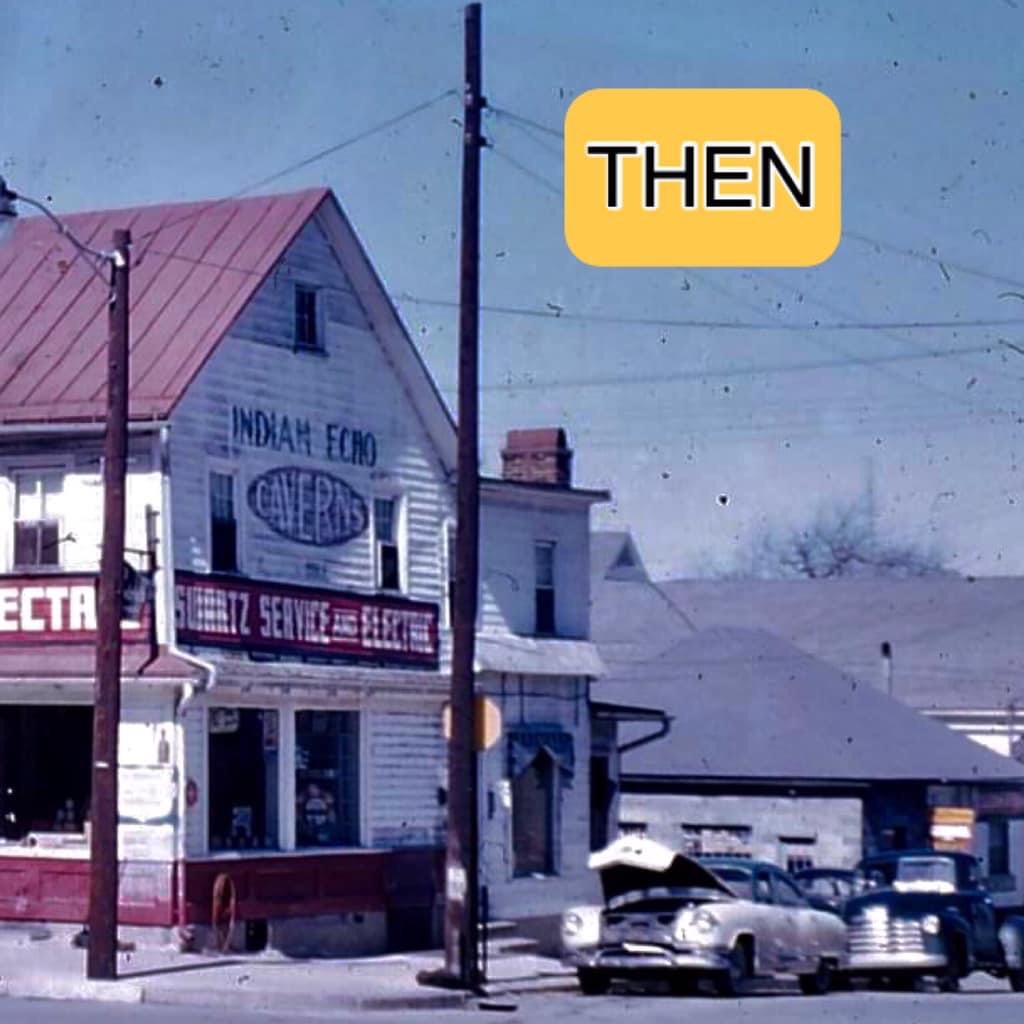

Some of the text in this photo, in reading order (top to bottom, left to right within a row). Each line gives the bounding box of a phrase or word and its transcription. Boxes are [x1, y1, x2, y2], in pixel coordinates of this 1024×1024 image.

[232, 405, 377, 468] INDIAN ECHO
[255, 472, 365, 545] CAVERNS
[259, 594, 331, 645] SERVICE
